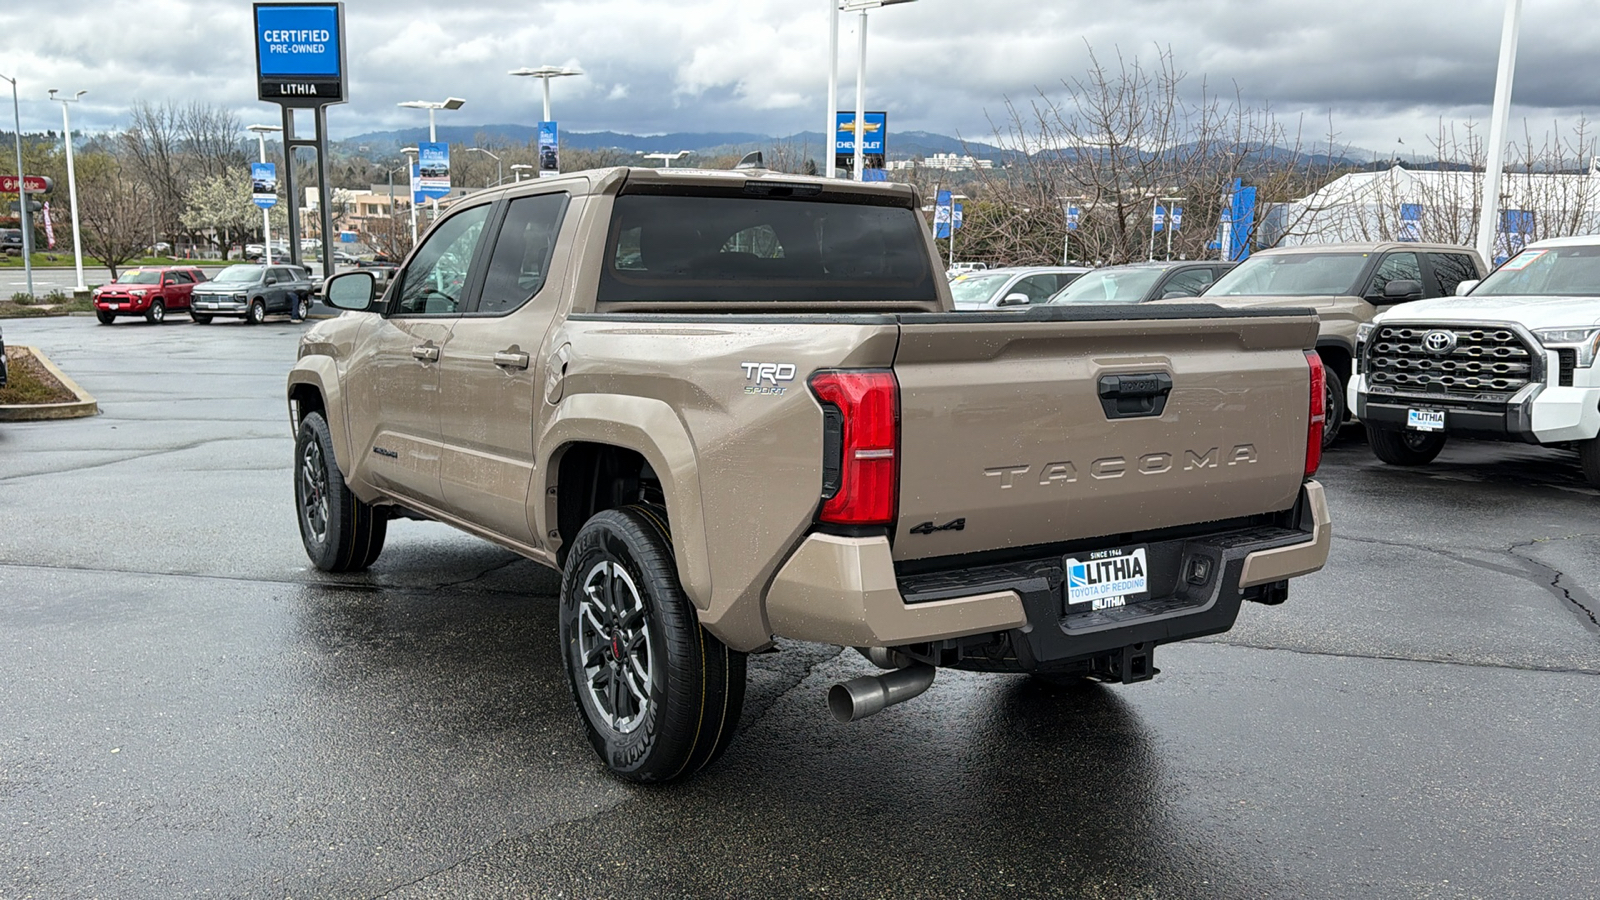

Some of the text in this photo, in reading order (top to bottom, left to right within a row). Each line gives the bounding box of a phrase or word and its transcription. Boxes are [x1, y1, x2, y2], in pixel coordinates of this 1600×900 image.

[263, 30, 330, 43] CERTIFIED
[270, 44, 325, 53] PRE-OWNED
[280, 83, 317, 95] LITHIA
[836, 141, 881, 149] CHEVOLET
[741, 362, 796, 385] TRD
[744, 386, 787, 395] SPORT
[1121, 380, 1155, 390] TOYOTA
[1417, 412, 1443, 422] LITHIA
[984, 443, 1258, 489] TACOMA
[1090, 548, 1122, 559] SINCE 1946
[1086, 556, 1144, 585] LITHIA
[1070, 578, 1144, 598] TOYOTA OF REDDING
[1100, 595, 1126, 609] LITHIA
